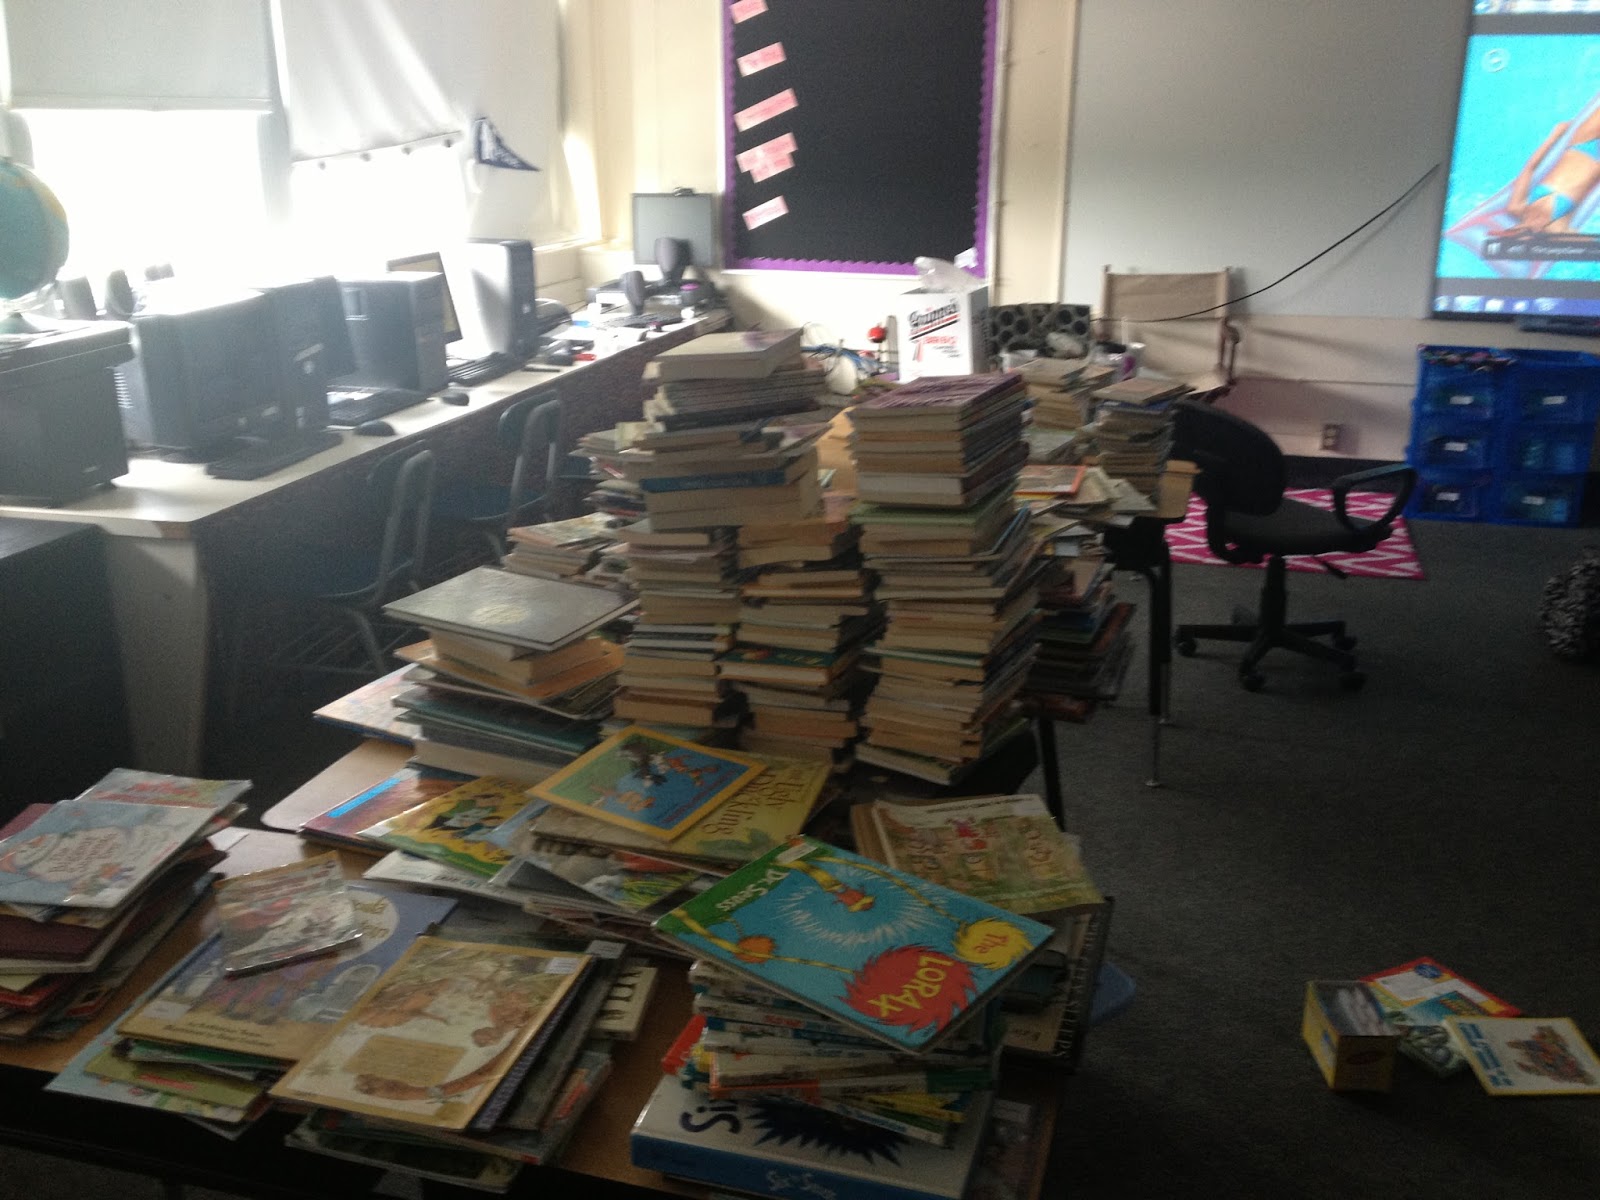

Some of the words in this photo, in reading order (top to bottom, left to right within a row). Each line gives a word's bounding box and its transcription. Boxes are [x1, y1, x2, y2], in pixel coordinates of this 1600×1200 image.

[715, 881, 769, 912] Seuss
[974, 933, 1010, 955] The
[867, 955, 956, 1018] LORAX
